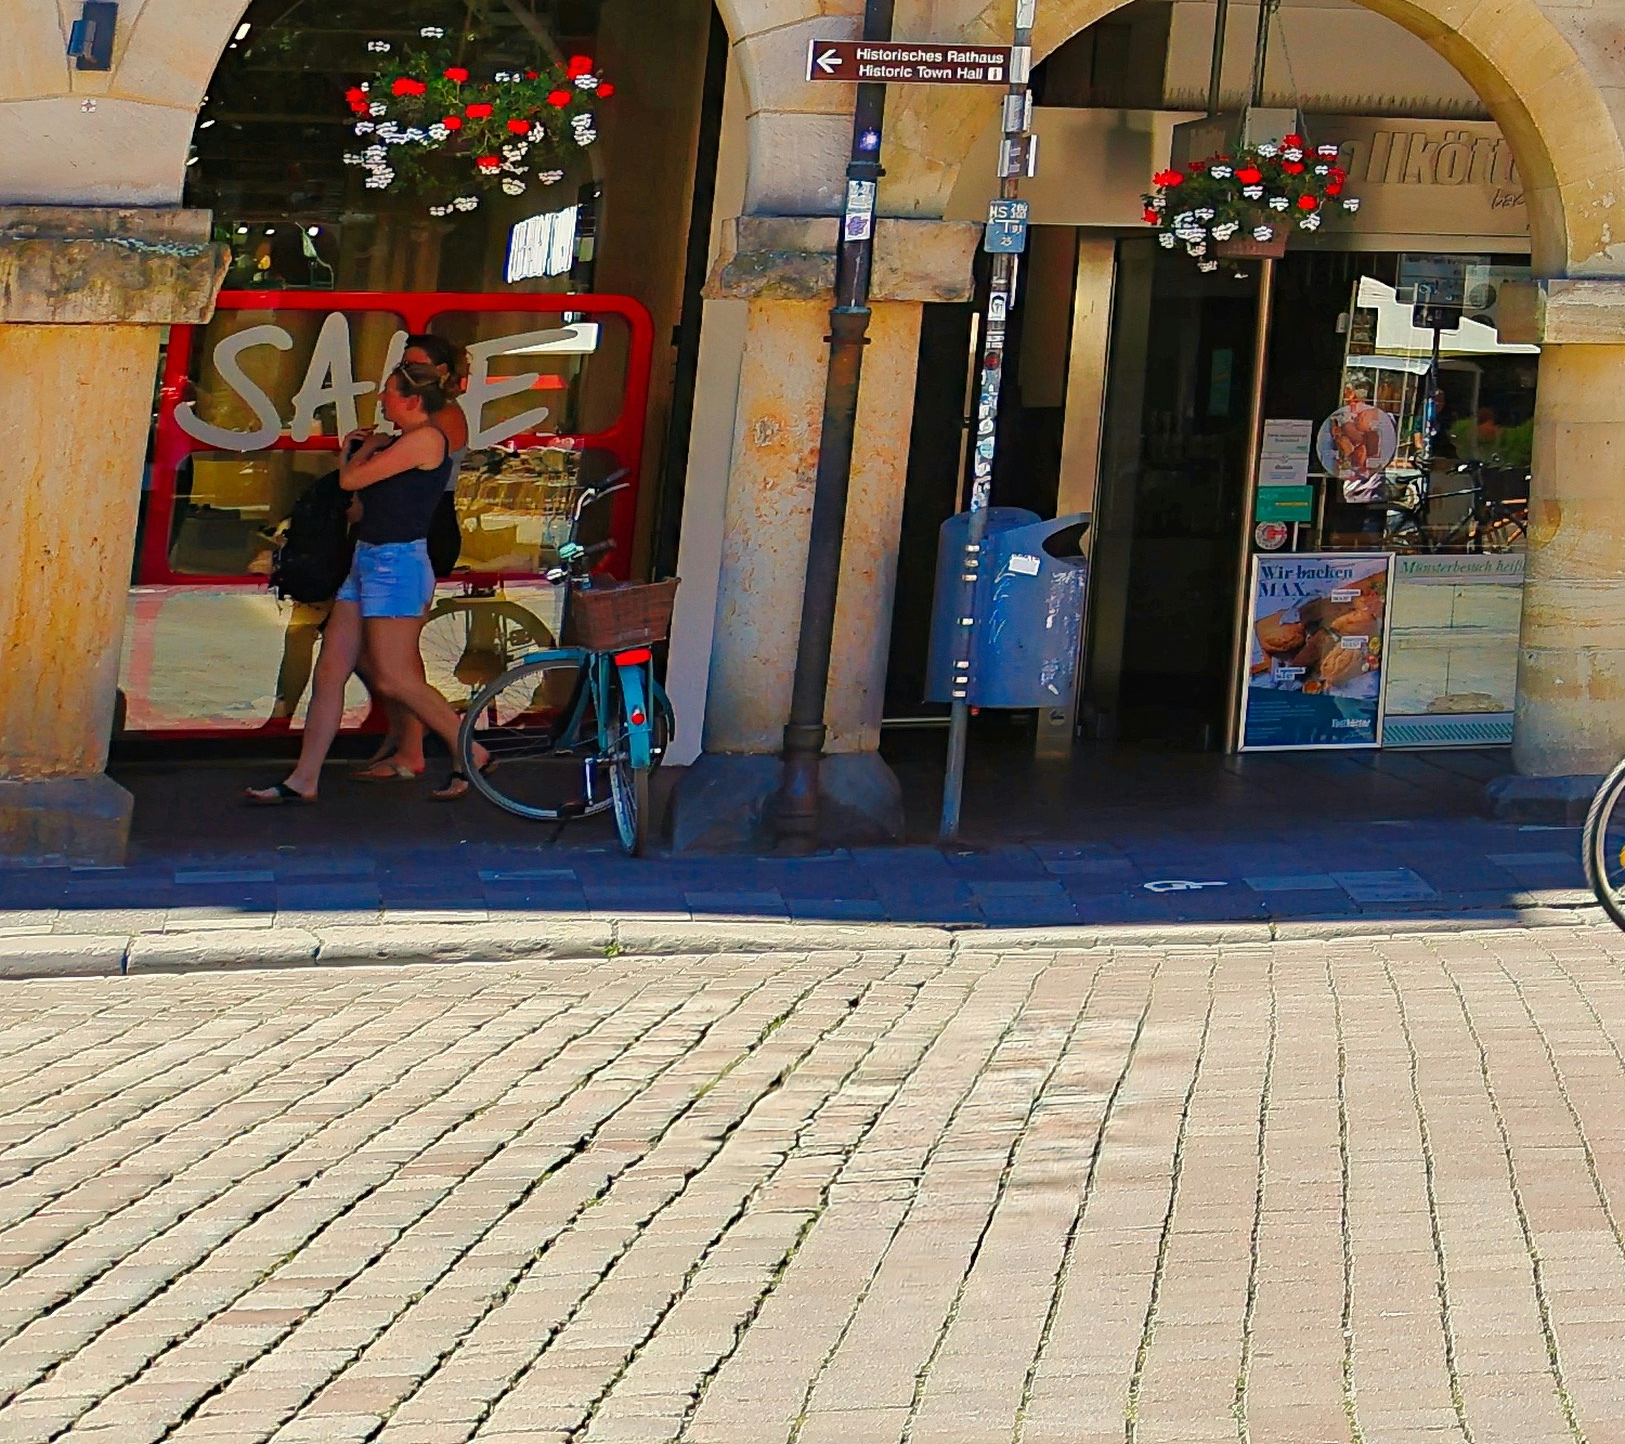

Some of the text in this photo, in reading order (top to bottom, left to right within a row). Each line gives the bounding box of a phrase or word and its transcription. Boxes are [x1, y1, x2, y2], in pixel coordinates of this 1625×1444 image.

[856, 47, 1004, 65] Historisches Rathaus
[859, 64, 983, 80] Historic Town Hall
[1261, 564, 1353, 581] Wir backen
